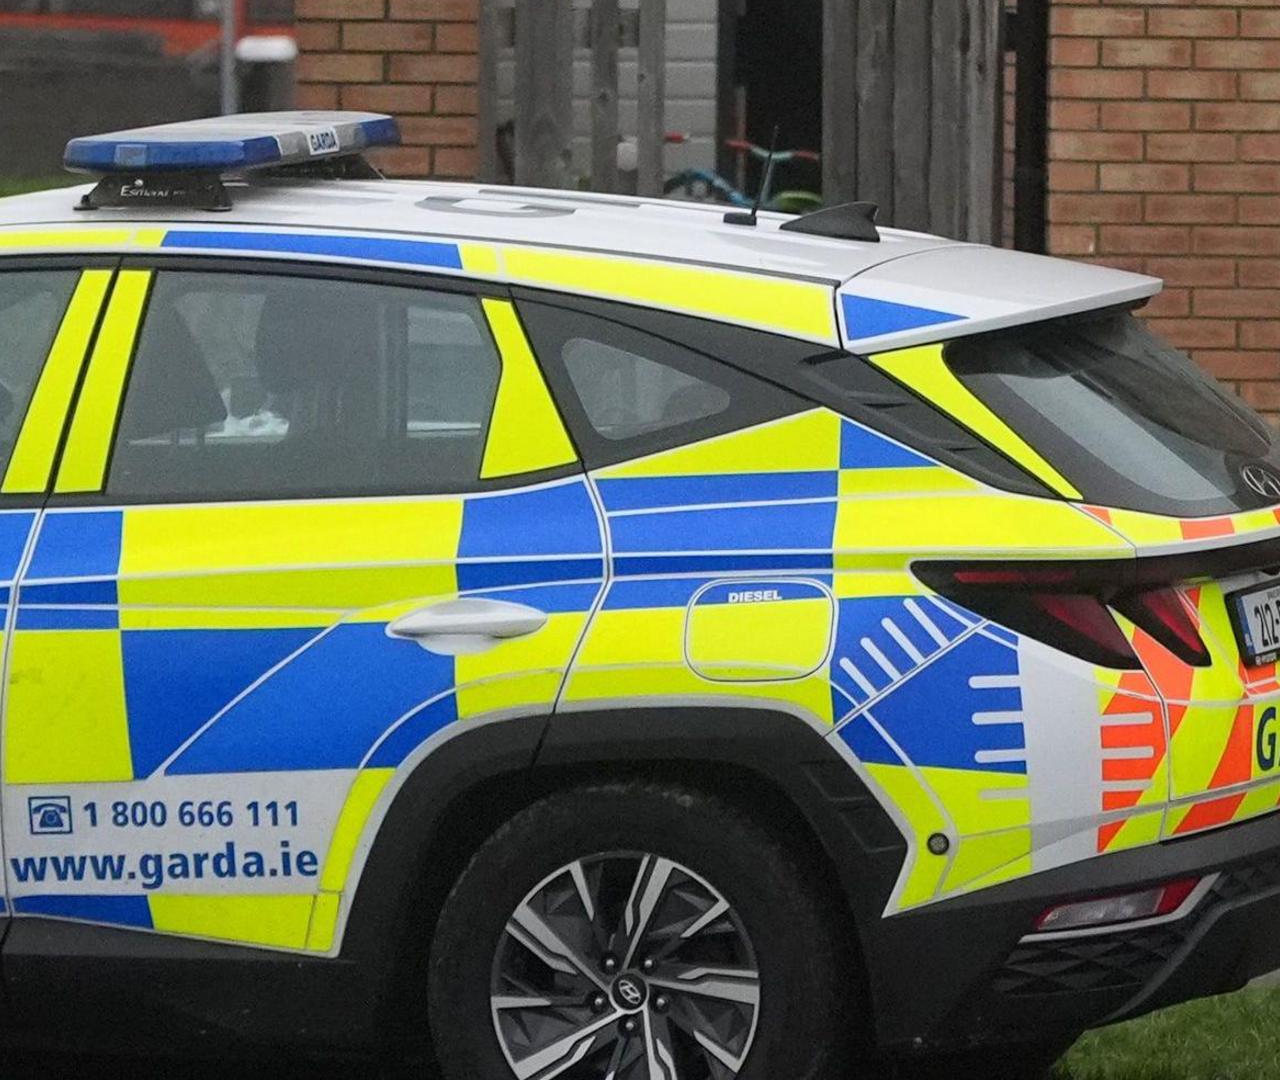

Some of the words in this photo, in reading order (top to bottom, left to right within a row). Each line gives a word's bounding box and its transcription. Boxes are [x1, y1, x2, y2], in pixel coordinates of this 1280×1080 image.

[728, 590, 782, 603] DIESEL
[83, 801, 98, 827] 1
[111, 801, 168, 827] 800
[178, 801, 234, 827] 666
[246, 801, 298, 827] 111
[10, 841, 318, 890] www.garda.ie
